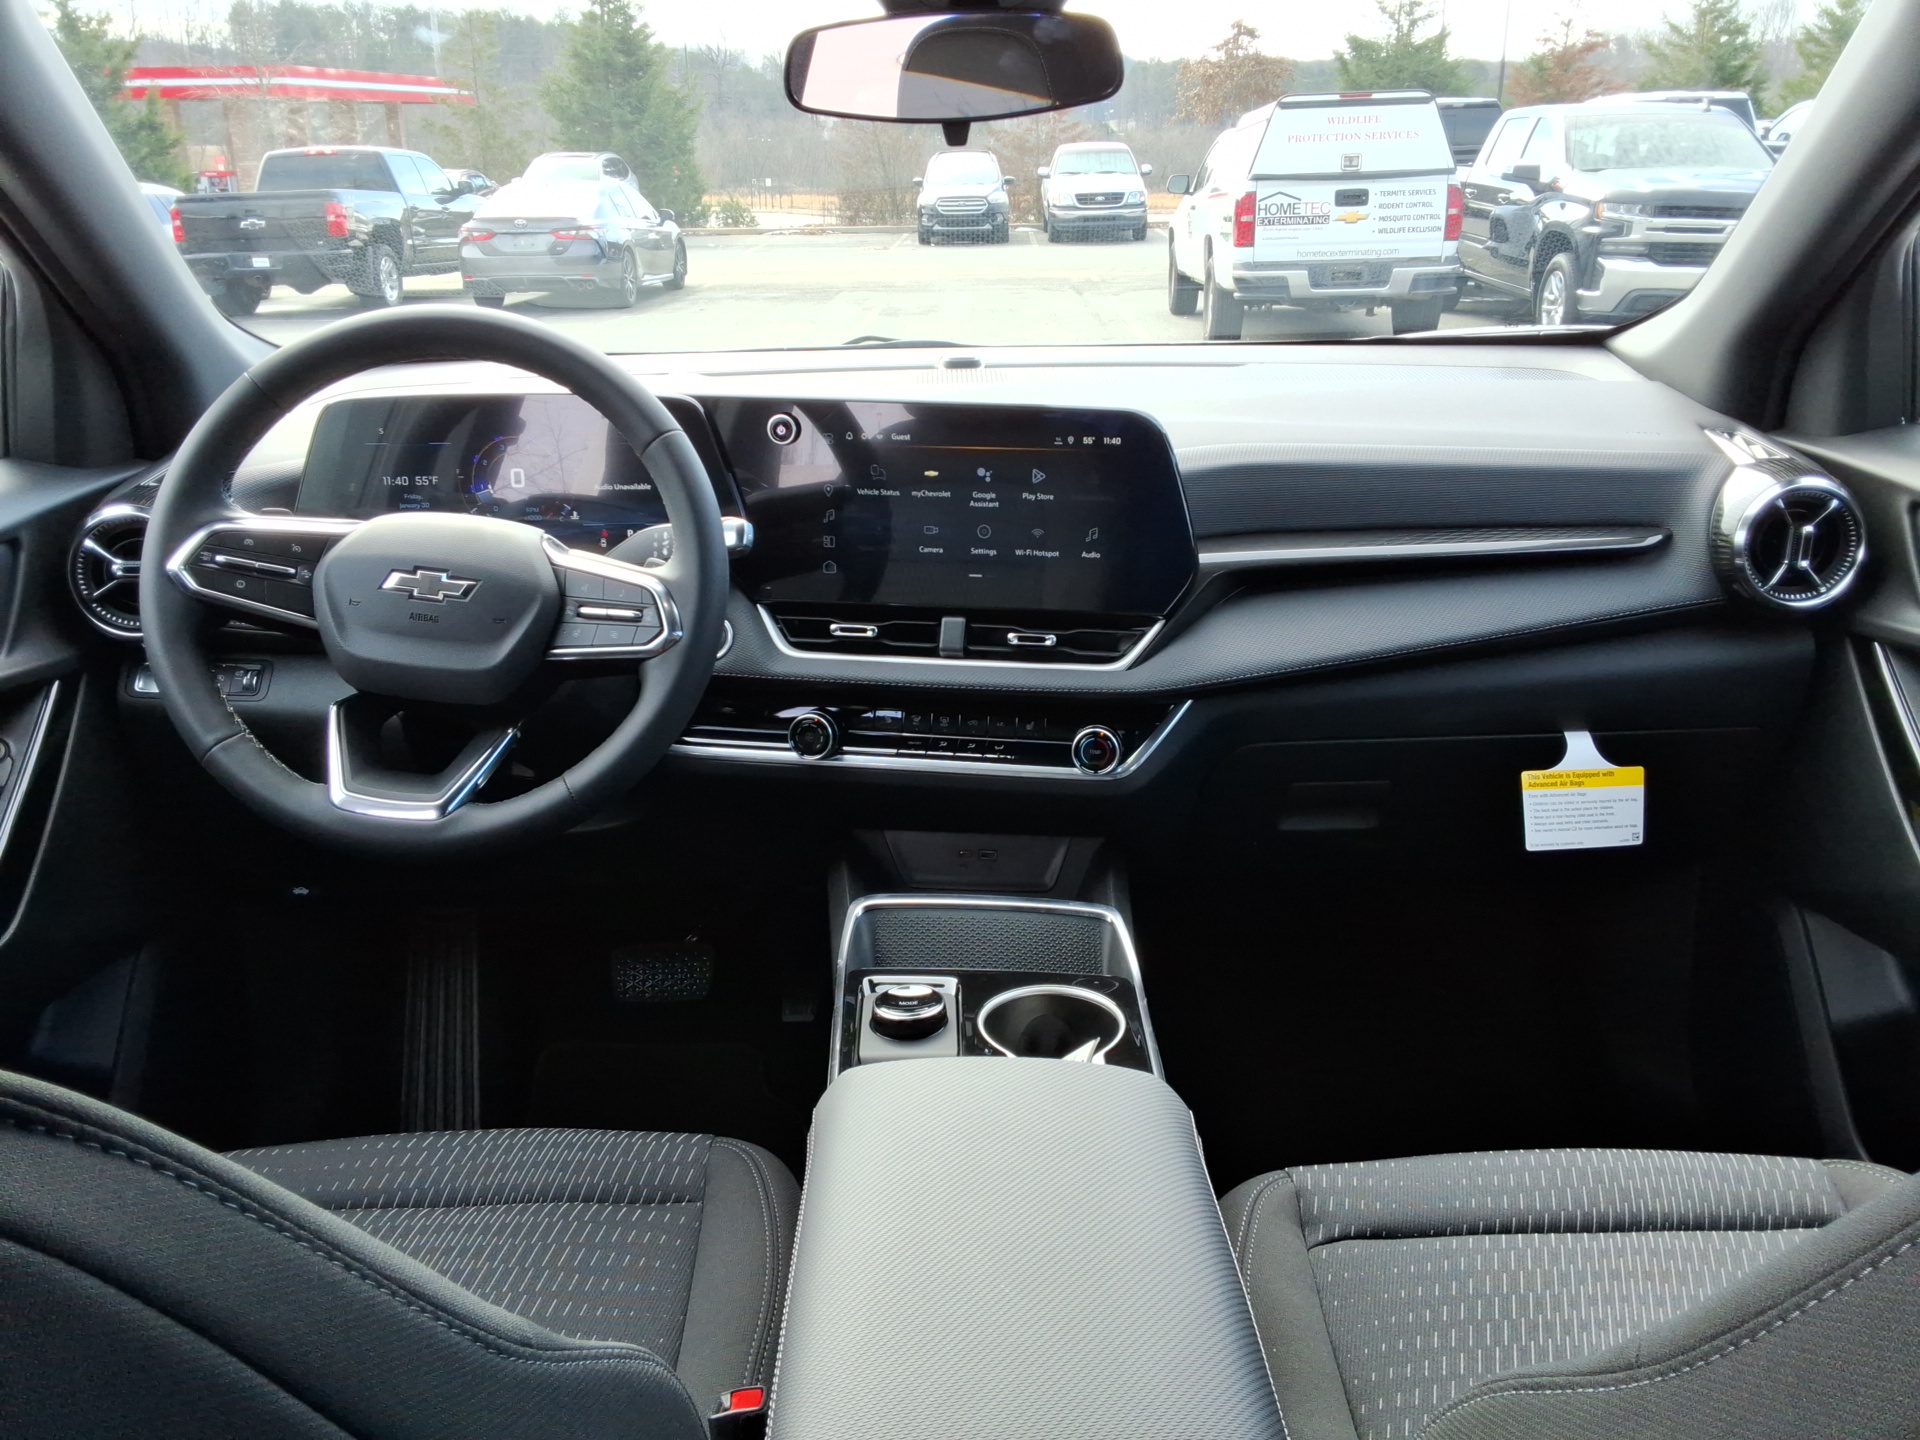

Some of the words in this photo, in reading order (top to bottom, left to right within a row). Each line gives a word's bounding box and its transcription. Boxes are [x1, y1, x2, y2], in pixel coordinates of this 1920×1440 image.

[1328, 115, 1381, 124] WILDLIFE
[1288, 132, 1361, 143] PROTECTION
[1365, 130, 1420, 140] SERVICES
[1258, 202, 1330, 216] HOMETEC
[1257, 216, 1329, 226] EXTERMINATING
[1296, 248, 1400, 258] hometecexterminating.com
[891, 432, 911, 441] Guest
[1103, 437, 1122, 445] 11:40
[382, 476, 409, 486] 11:40
[415, 475, 439, 486] 55°F
[614, 483, 652, 491] Unavailable
[857, 488, 880, 496] Vehicle
[880, 489, 900, 497] Status
[912, 490, 951, 498] myChevrolet
[972, 491, 996, 500] Google
[1022, 492, 1036, 501] Play
[1036, 493, 1054, 501] Store
[969, 500, 999, 508] Assistant
[919, 546, 944, 554] Camera
[970, 548, 997, 556] Settings
[1033, 550, 1060, 558] Hotspot
[1081, 551, 1101, 559] Audio
[408, 612, 440, 624] AIRBAG
[1542, 772, 1564, 780] Vehicle
[1572, 770, 1600, 780] Equipped
[1528, 780, 1558, 788] Advanced
[1570, 780, 1585, 788] Bags
